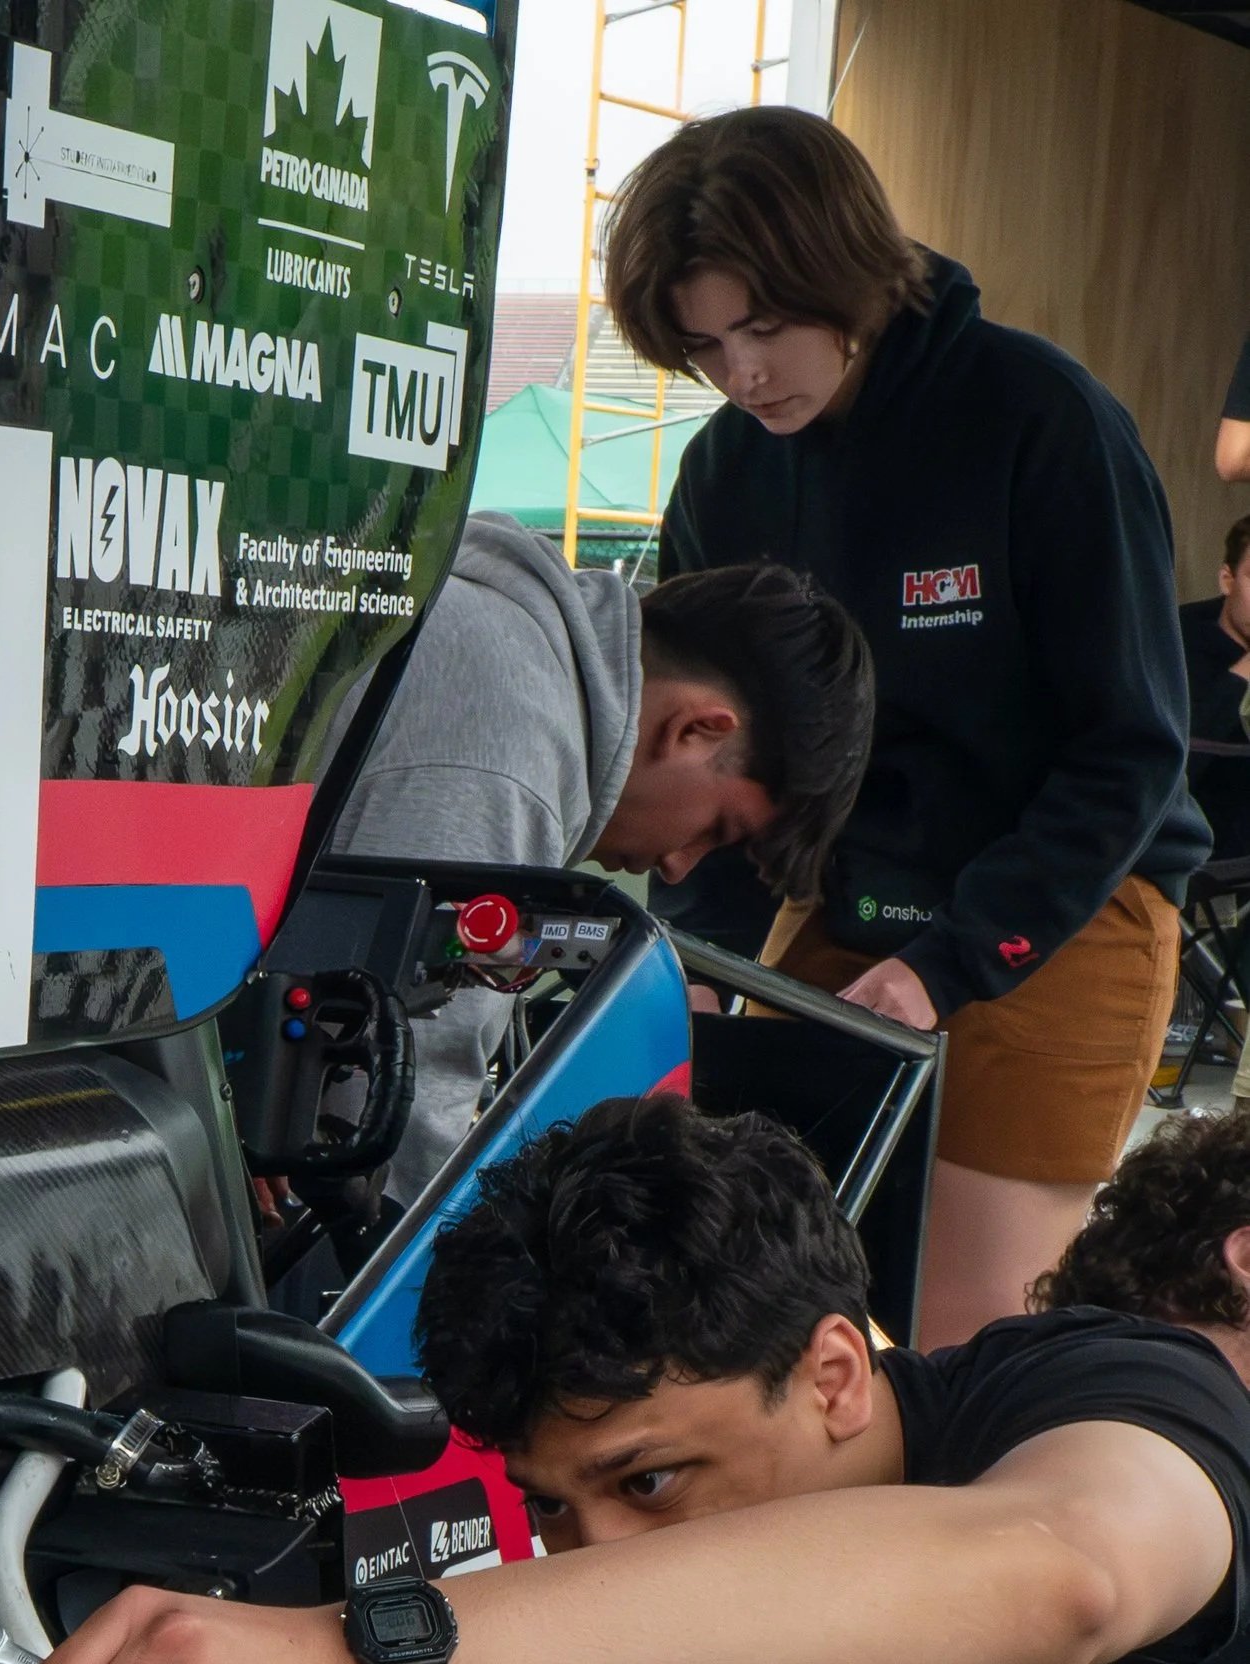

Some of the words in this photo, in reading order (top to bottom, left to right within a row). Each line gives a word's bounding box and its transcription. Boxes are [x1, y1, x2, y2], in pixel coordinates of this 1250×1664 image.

[266, 247, 351, 299] LUBRICANTS
[404, 253, 475, 299] TESLA
[190, 320, 322, 402] MAGNA
[362, 358, 445, 446] TMU
[56, 456, 225, 597] NOVAX
[238, 532, 299, 571] Faculty
[301, 538, 320, 567] of
[324, 535, 413, 581] Engineering
[235, 577, 249, 606] &
[252, 578, 357, 612] Architectural
[359, 587, 414, 617] science
[901, 608, 983, 629] Internship
[62, 606, 154, 637] ELECTRICAL
[156, 615, 212, 642] SAFETY
[117, 662, 270, 757] Hoosier
[544, 926, 567, 937] IMD
[577, 924, 605, 938] BMS
[451, 1515, 491, 1554] BENDER
[368, 1541, 410, 1580] EINTAC
